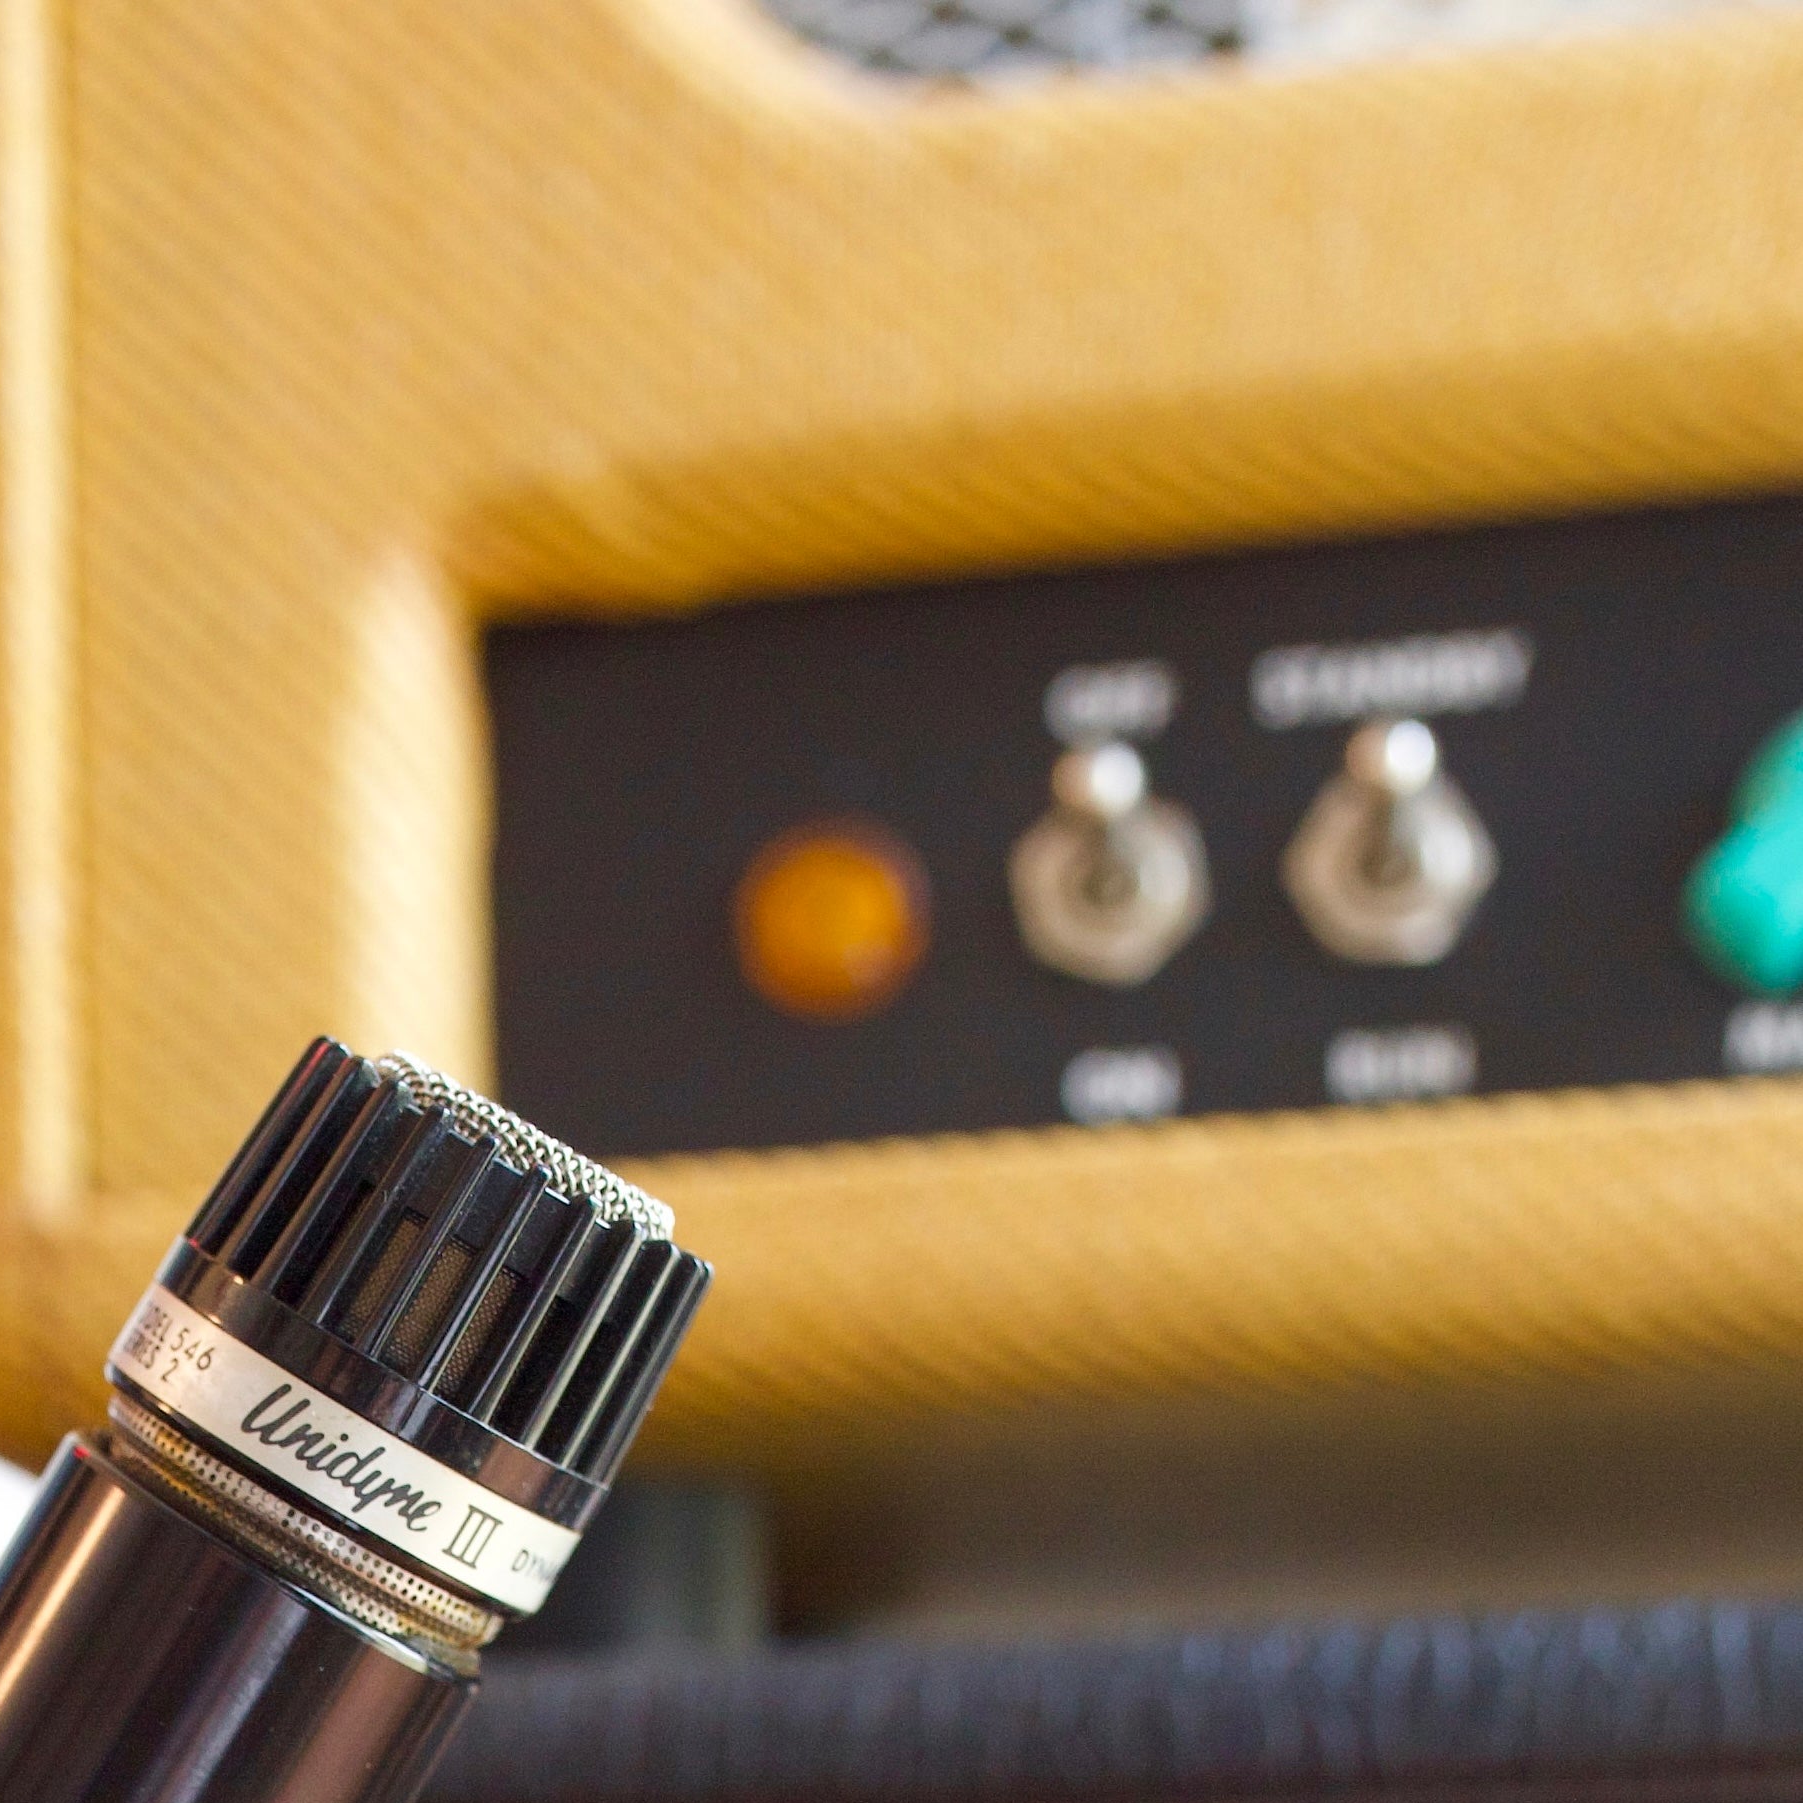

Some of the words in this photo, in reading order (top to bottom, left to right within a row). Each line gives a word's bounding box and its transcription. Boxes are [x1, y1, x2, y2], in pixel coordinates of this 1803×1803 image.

[160, 1358, 180, 1384] 2
[170, 1327, 216, 1371] 546
[240, 1384, 442, 1533] Unidyne
[441, 1504, 504, 1570] III
